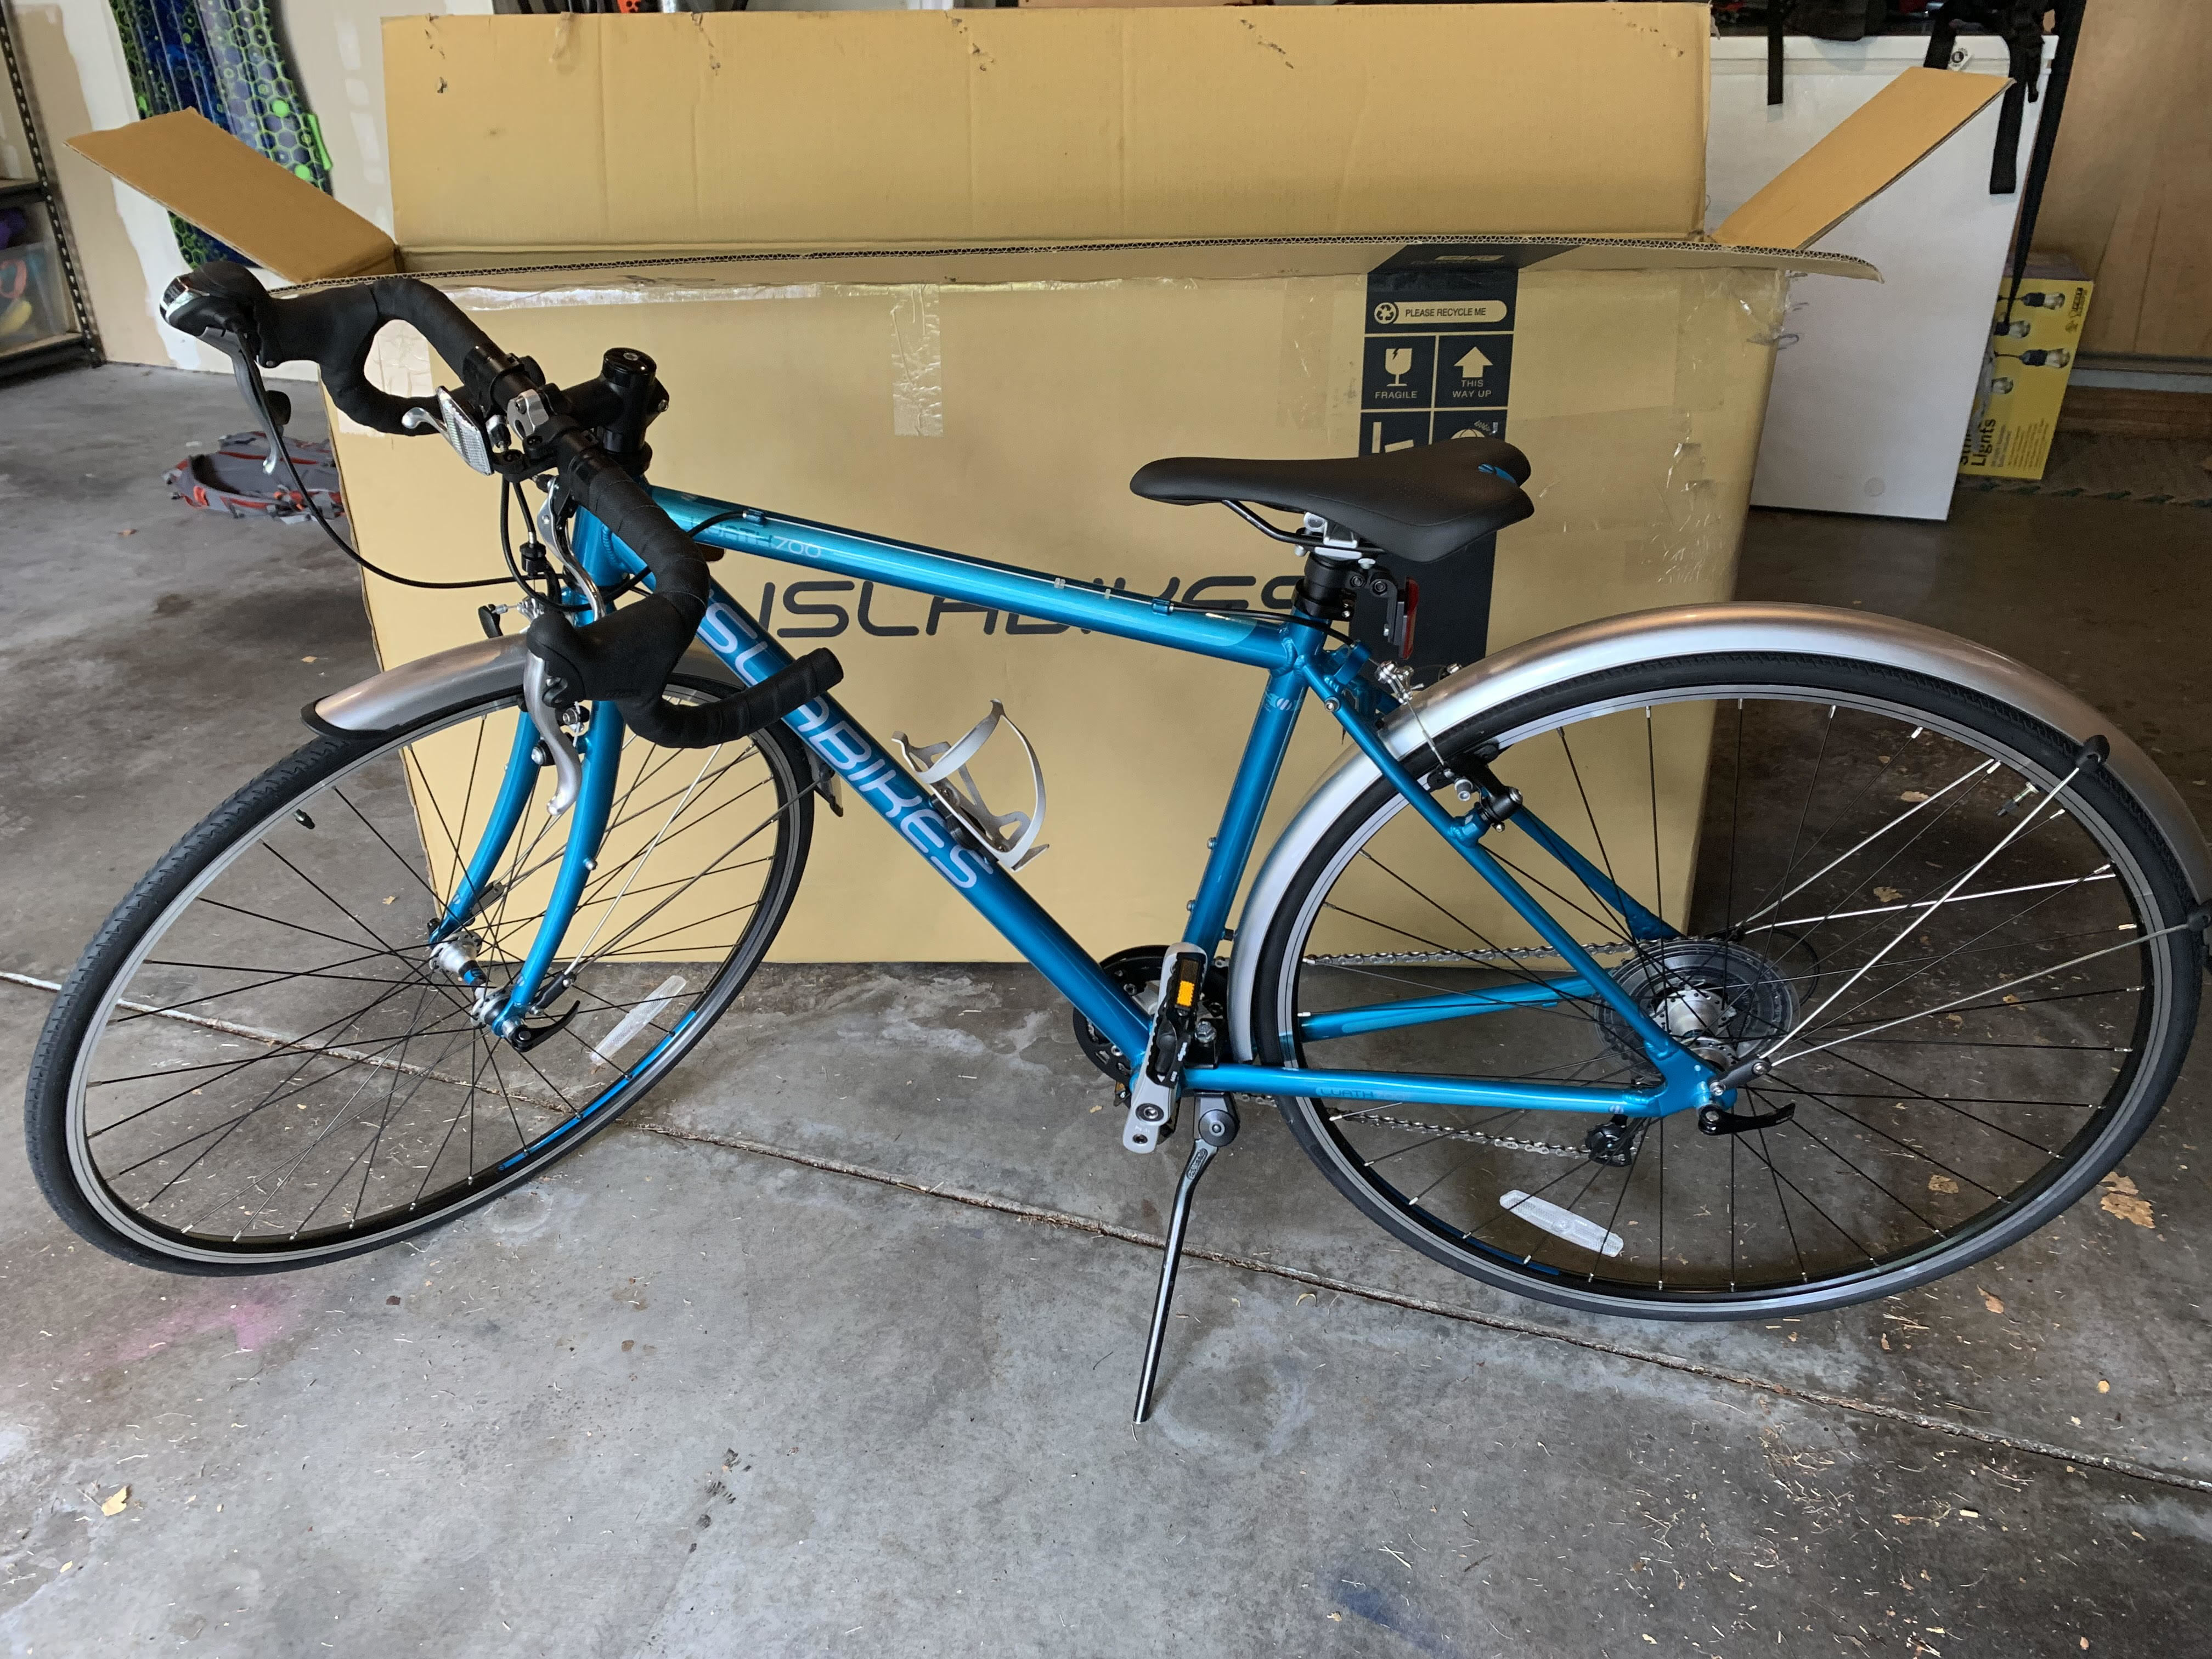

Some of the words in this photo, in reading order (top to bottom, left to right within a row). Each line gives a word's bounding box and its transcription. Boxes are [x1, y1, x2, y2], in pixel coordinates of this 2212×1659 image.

[1405, 308, 1435, 317] PLEASE
[1437, 308, 1473, 317] RECYCLE
[1475, 308, 1486, 316] ME
[1462, 379, 1483, 387] THIS
[1375, 391, 1418, 399] FRAGILE
